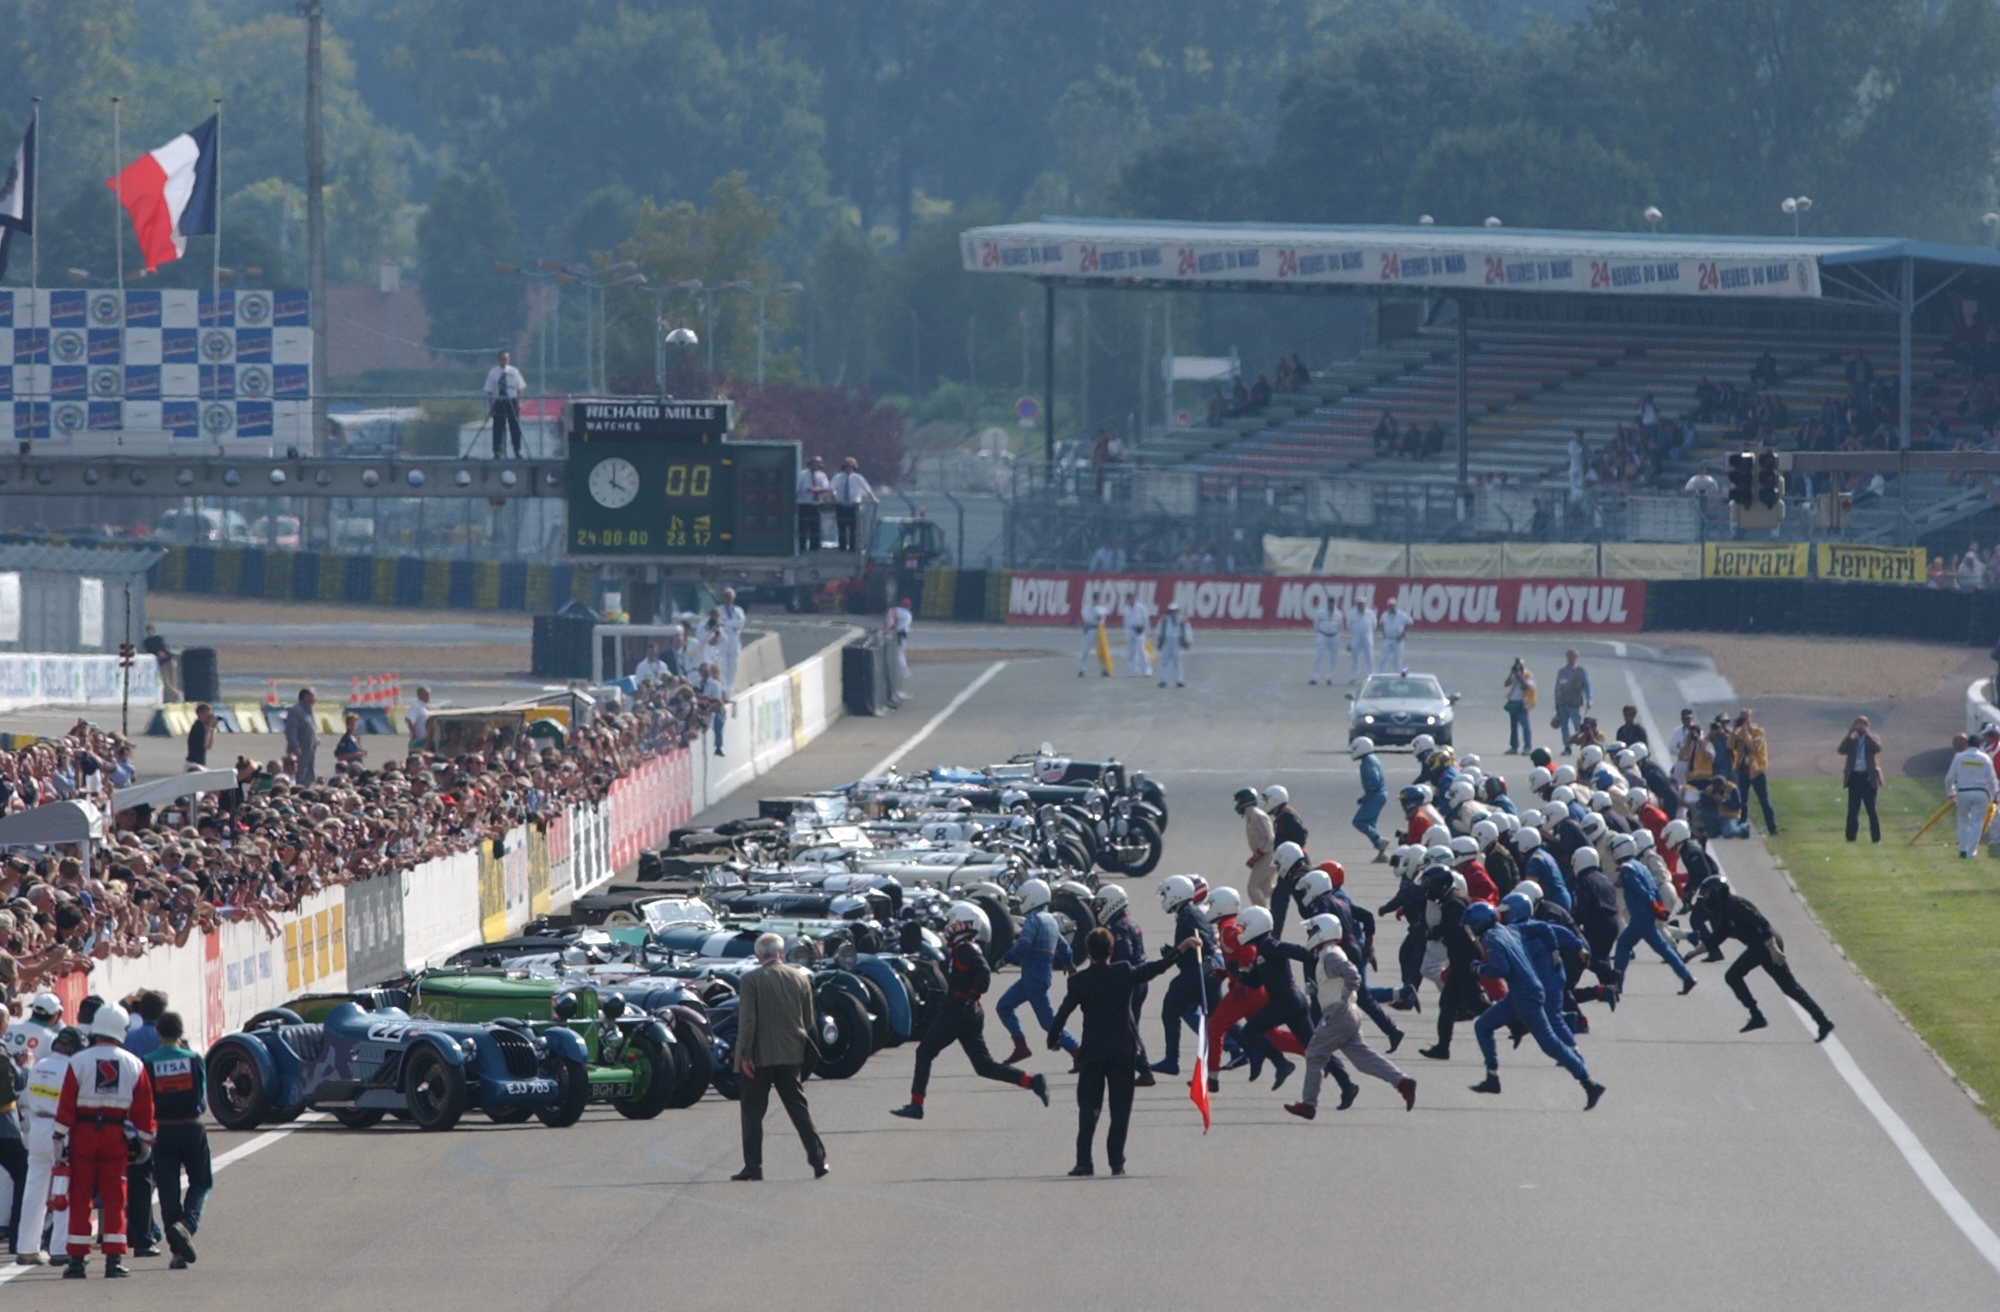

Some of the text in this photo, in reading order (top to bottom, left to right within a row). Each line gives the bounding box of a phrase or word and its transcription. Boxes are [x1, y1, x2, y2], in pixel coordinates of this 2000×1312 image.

[982, 241, 1001, 268] 24
[1080, 245, 1099, 272] 24
[1177, 248, 1197, 275] 24
[1278, 249, 1298, 277] 24
[1380, 252, 1400, 279] 24
[1484, 256, 1505, 284] 24
[1590, 260, 1680, 288] 24 HEURES DU MANS
[1698, 262, 1790, 291] 24 HEURES DU MANS
[585, 406, 716, 420] RICHARD MILLE
[586, 421, 641, 431] WATCHES
[665, 465, 712, 496] 00
[1713, 545, 1797, 576] Ferrari
[1826, 546, 1916, 580] Ferrari
[1009, 577, 1070, 616] MOTUL
[1174, 580, 1263, 619] MOTUL
[1397, 583, 1500, 623] MOTUL
[1516, 584, 1627, 623] MOTUL
[935, 827, 947, 841] 8
[372, 1022, 405, 1039] 22
[156, 1061, 187, 1074] FFSA
[506, 1082, 550, 1094] EJJ 703
